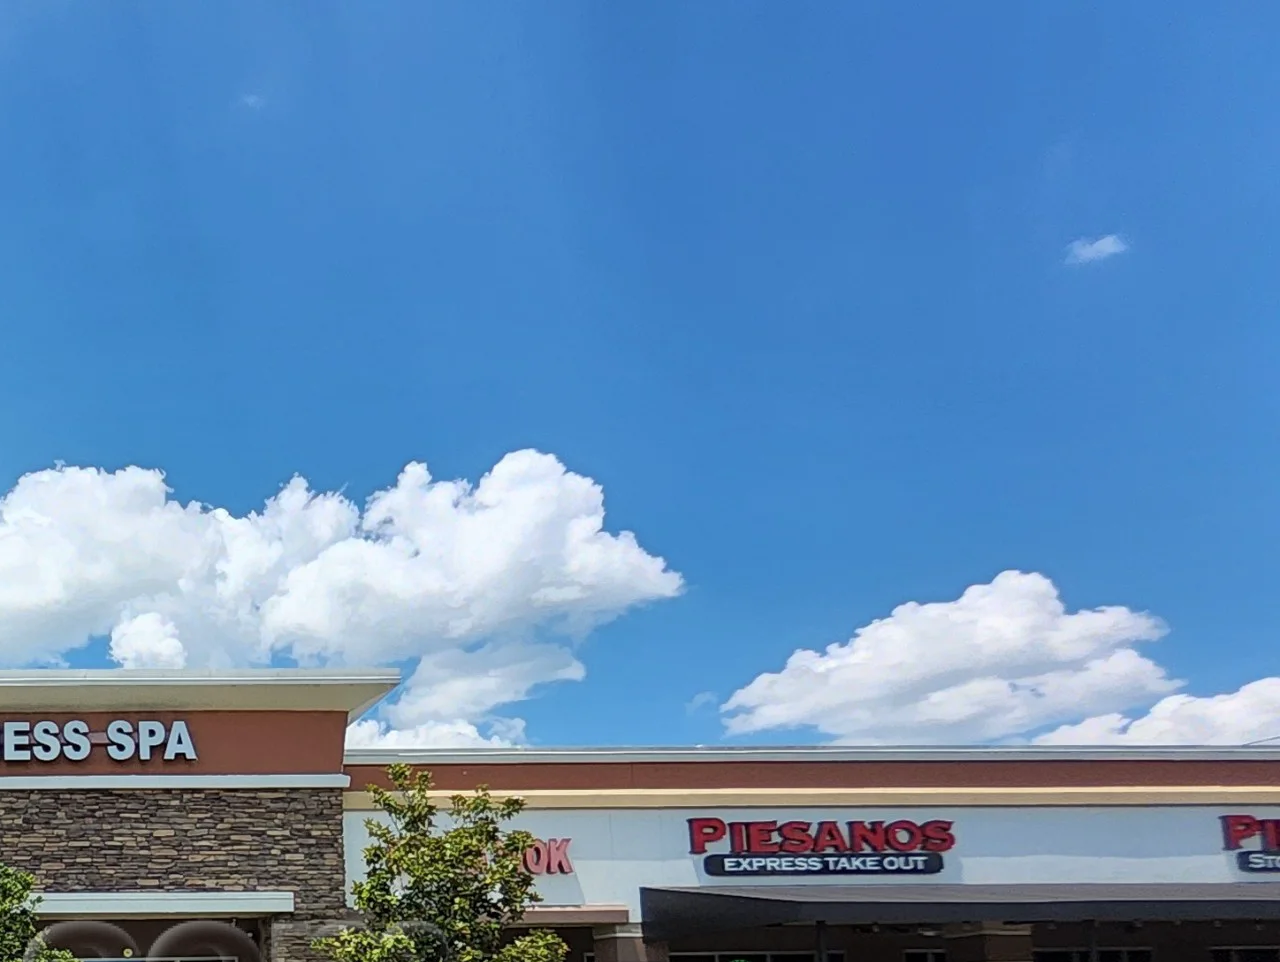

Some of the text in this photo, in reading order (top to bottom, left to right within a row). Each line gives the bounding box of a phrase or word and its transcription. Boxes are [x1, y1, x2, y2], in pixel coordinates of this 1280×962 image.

[106, 720, 199, 761] SPA
[686, 817, 956, 854] PIESANOS
[723, 855, 929, 872] EXPRESS TAKE OUT
